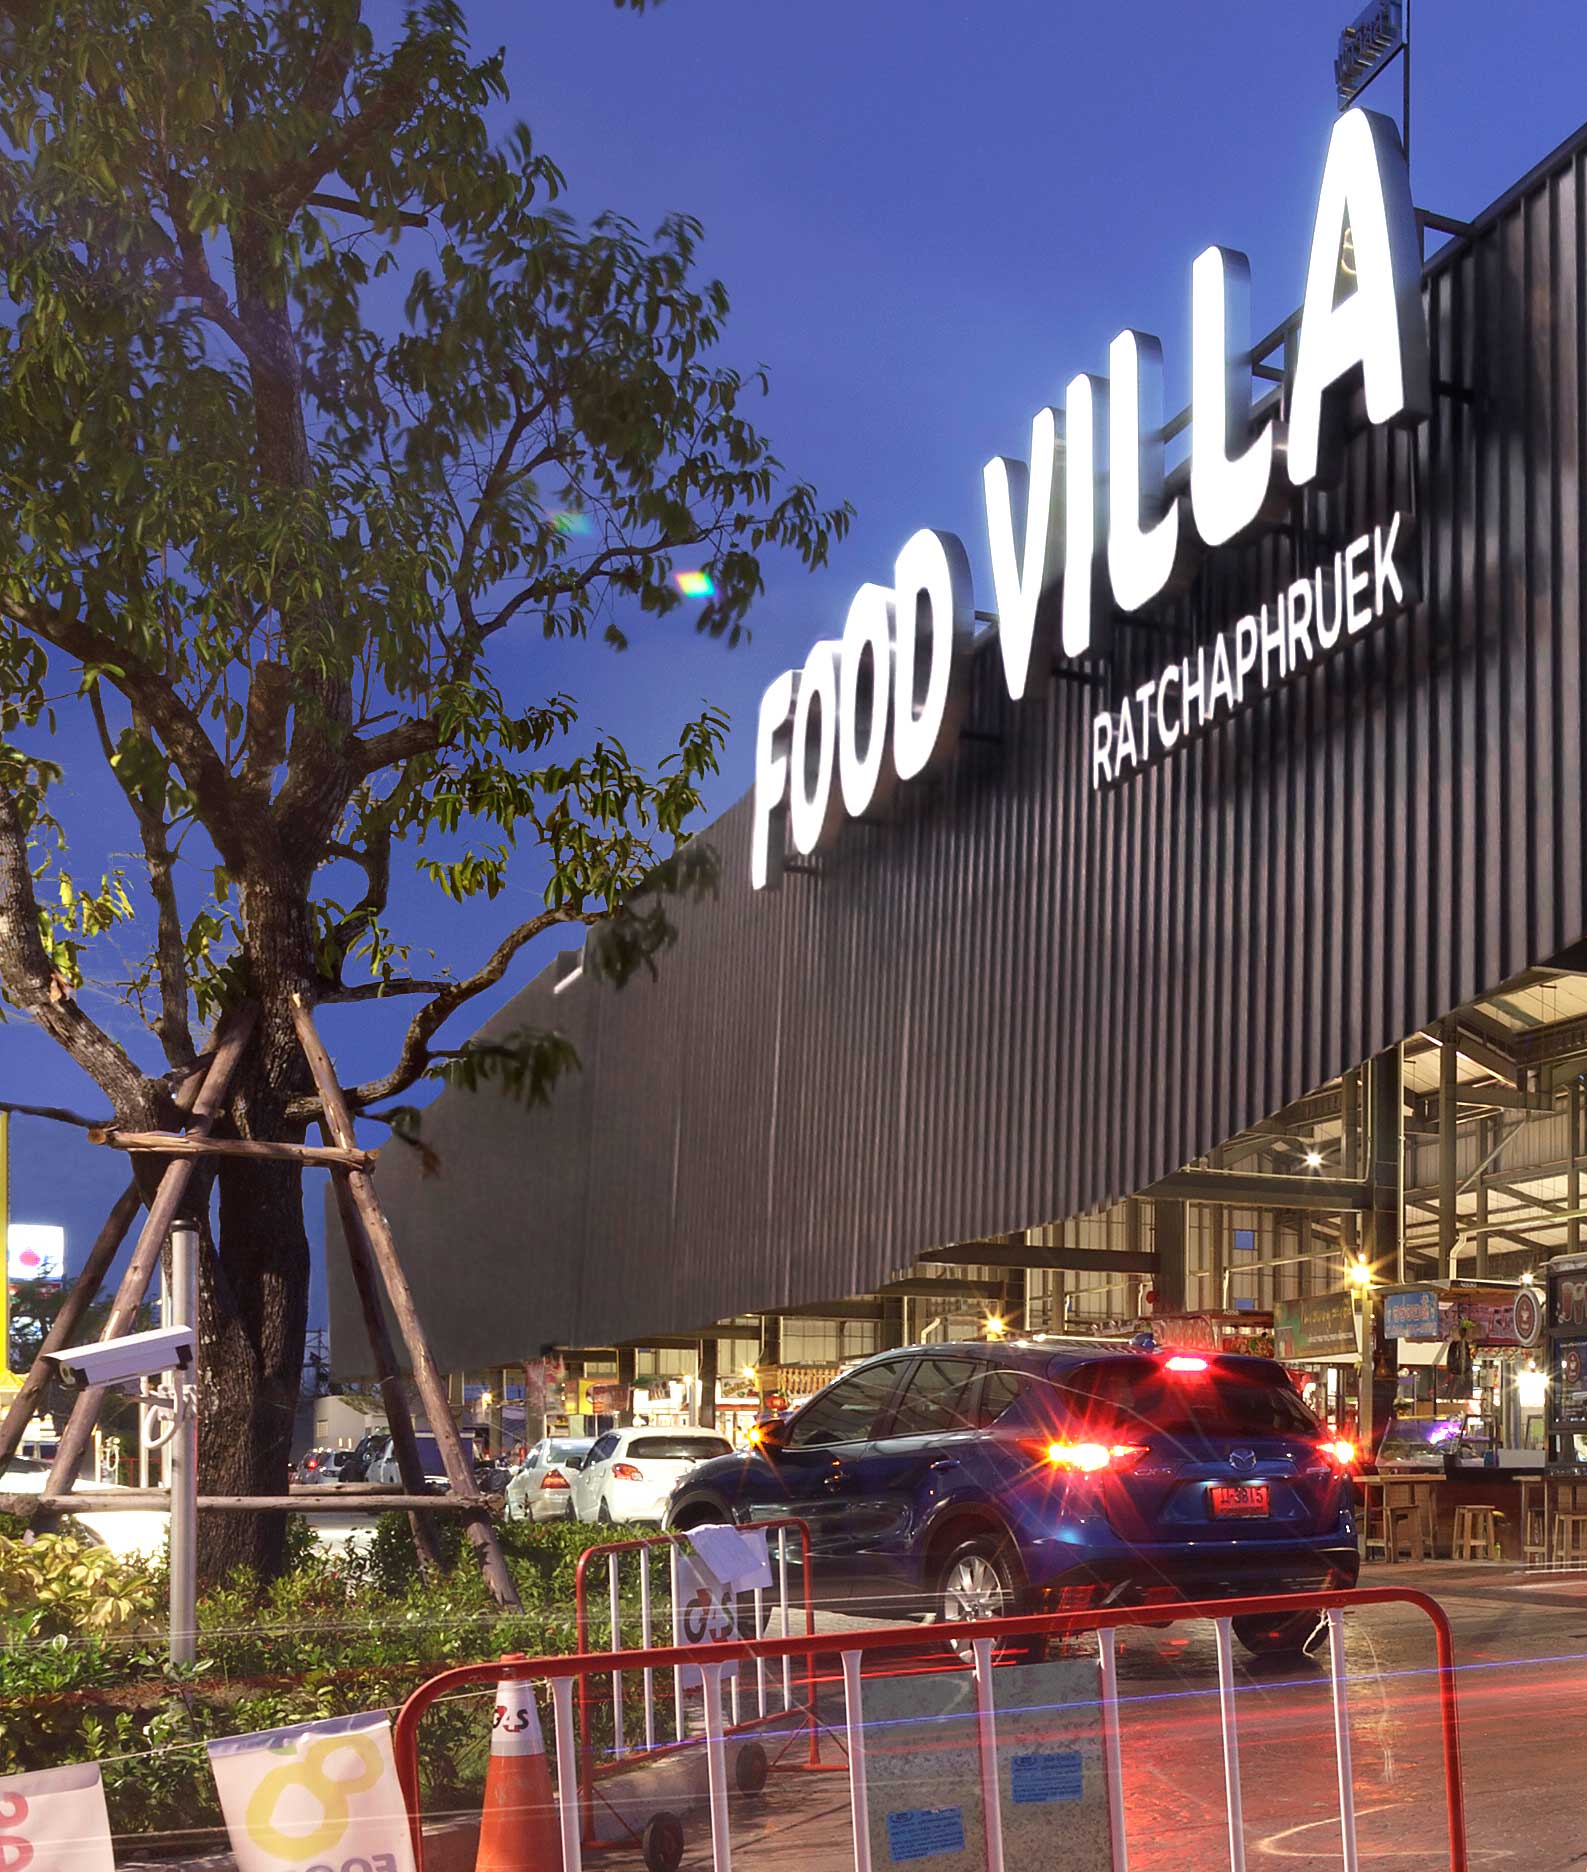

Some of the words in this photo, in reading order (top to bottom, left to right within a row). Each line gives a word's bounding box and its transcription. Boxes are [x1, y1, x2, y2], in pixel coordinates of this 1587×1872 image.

[752, 528, 954, 891] FOOD
[983, 107, 1407, 701] VILLA
[1091, 511, 1408, 790] RATCHAPHRUEK
[683, 1588, 735, 1645] G4S
